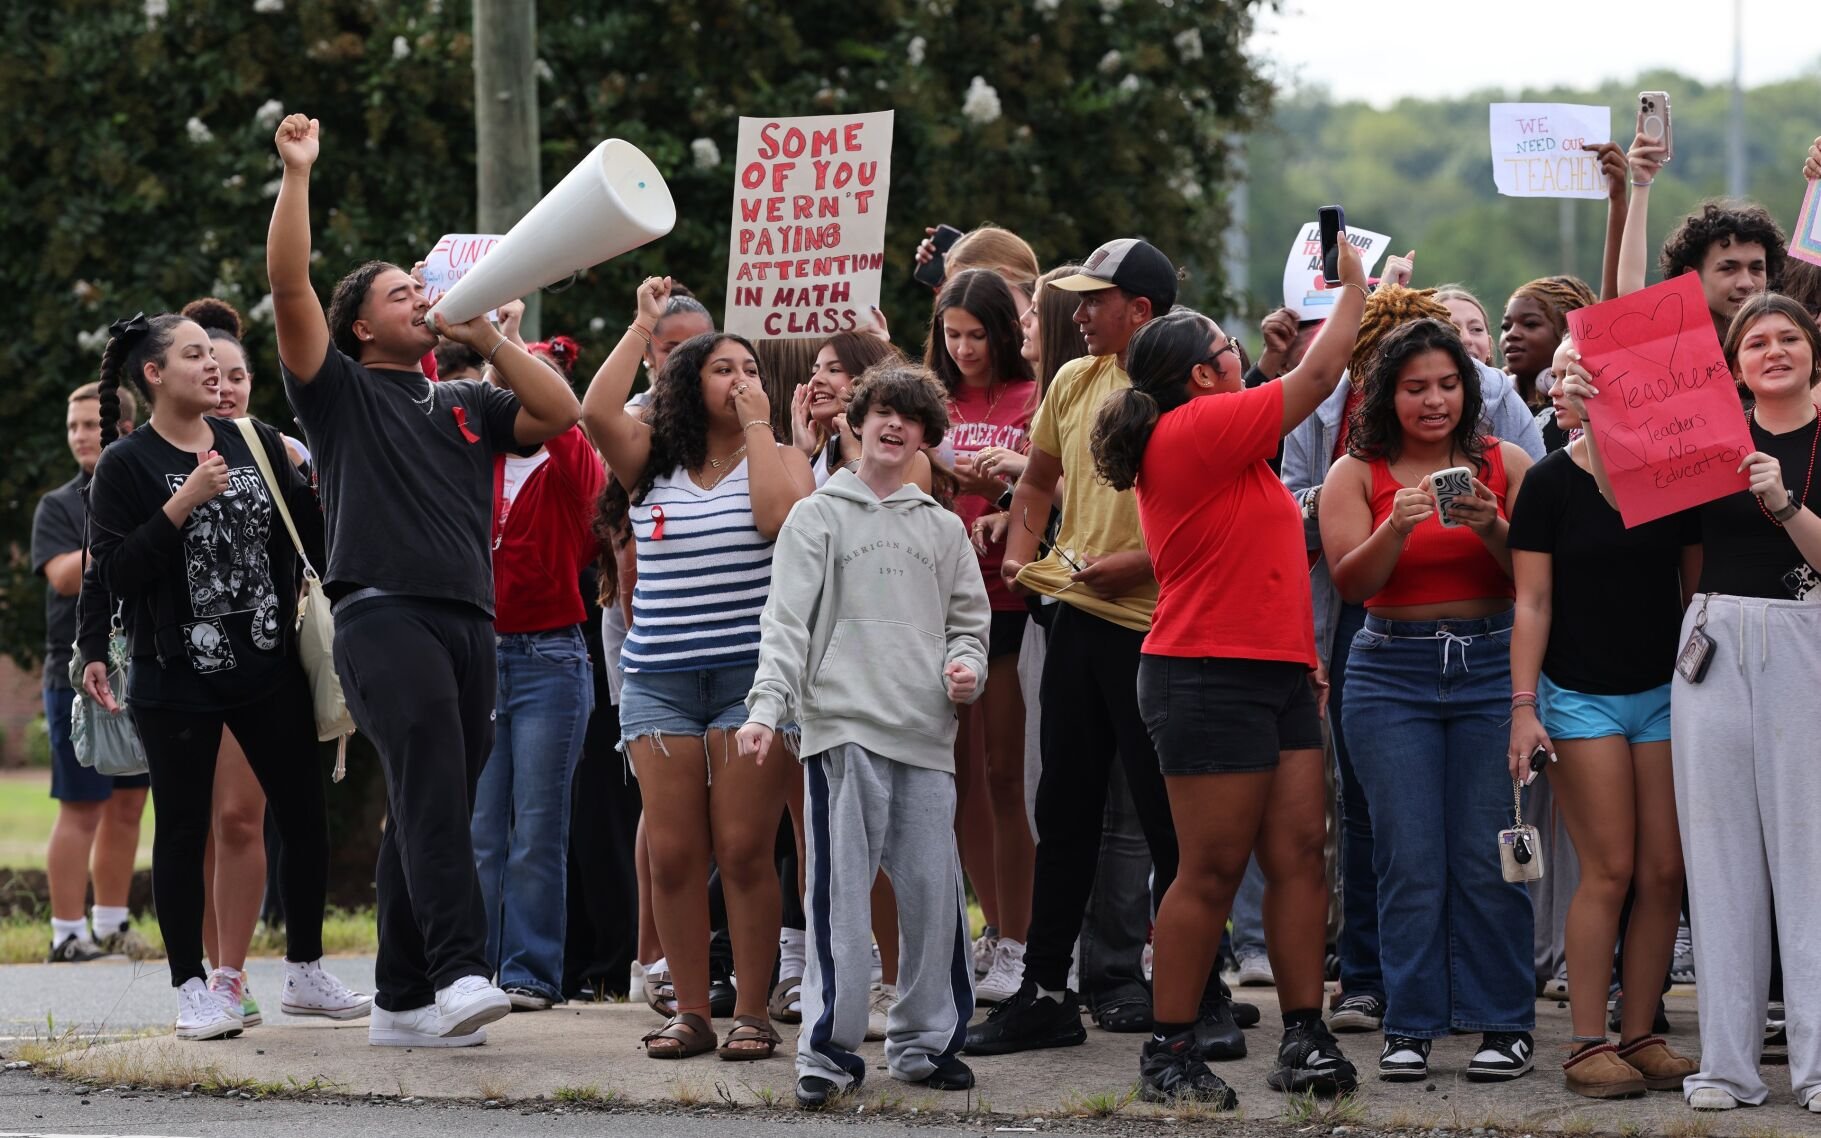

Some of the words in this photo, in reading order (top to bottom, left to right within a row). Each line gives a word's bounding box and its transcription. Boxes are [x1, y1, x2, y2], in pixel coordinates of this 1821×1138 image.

[1516, 116, 1548, 134] WE
[758, 122, 864, 160] SOME
[1516, 138, 1556, 153] NEED
[1562, 137, 1585, 151] OUR
[742, 162, 796, 192] OF
[813, 160, 877, 190] YOU
[1504, 155, 1608, 192] TEACHER
[740, 190, 874, 223] WERN'T
[739, 223, 841, 255] PAYING
[736, 252, 884, 281] ATTENTION
[735, 286, 763, 307] IN
[772, 281, 851, 307] MATH
[764, 309, 857, 335] CLASS
[1571, 318, 1604, 341] We
[1608, 359, 1729, 409] Teachers
[1638, 411, 1707, 445] Teachers
[1668, 438, 1697, 463] No
[1653, 444, 1749, 489] Education
[879, 567, 904, 576] 1977
[906, 546, 937, 577] EAGL
